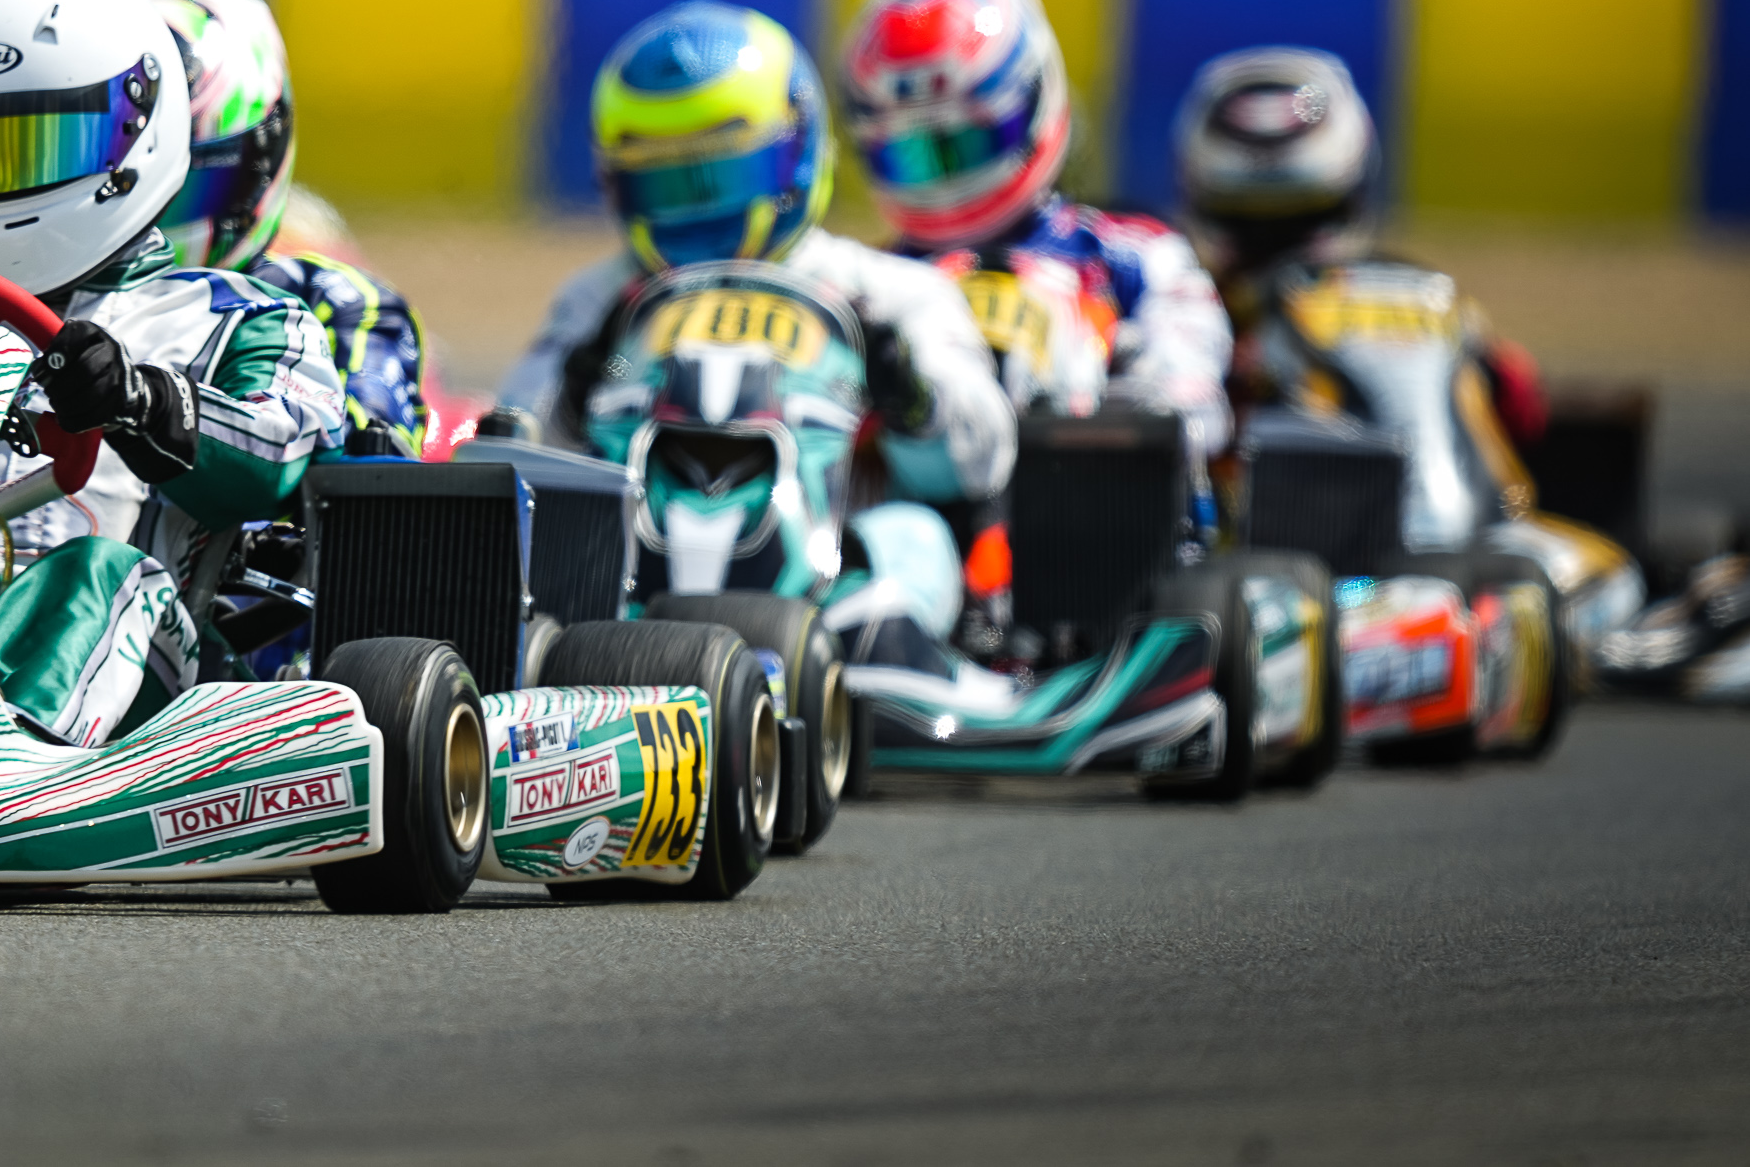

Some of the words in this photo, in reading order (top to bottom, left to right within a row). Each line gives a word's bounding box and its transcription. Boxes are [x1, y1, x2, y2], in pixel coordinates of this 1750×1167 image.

[159, 793, 241, 835] TONY
[260, 773, 341, 814] KART
[513, 769, 566, 813] TONY
[577, 754, 613, 798] KART
[626, 708, 700, 861] 733
